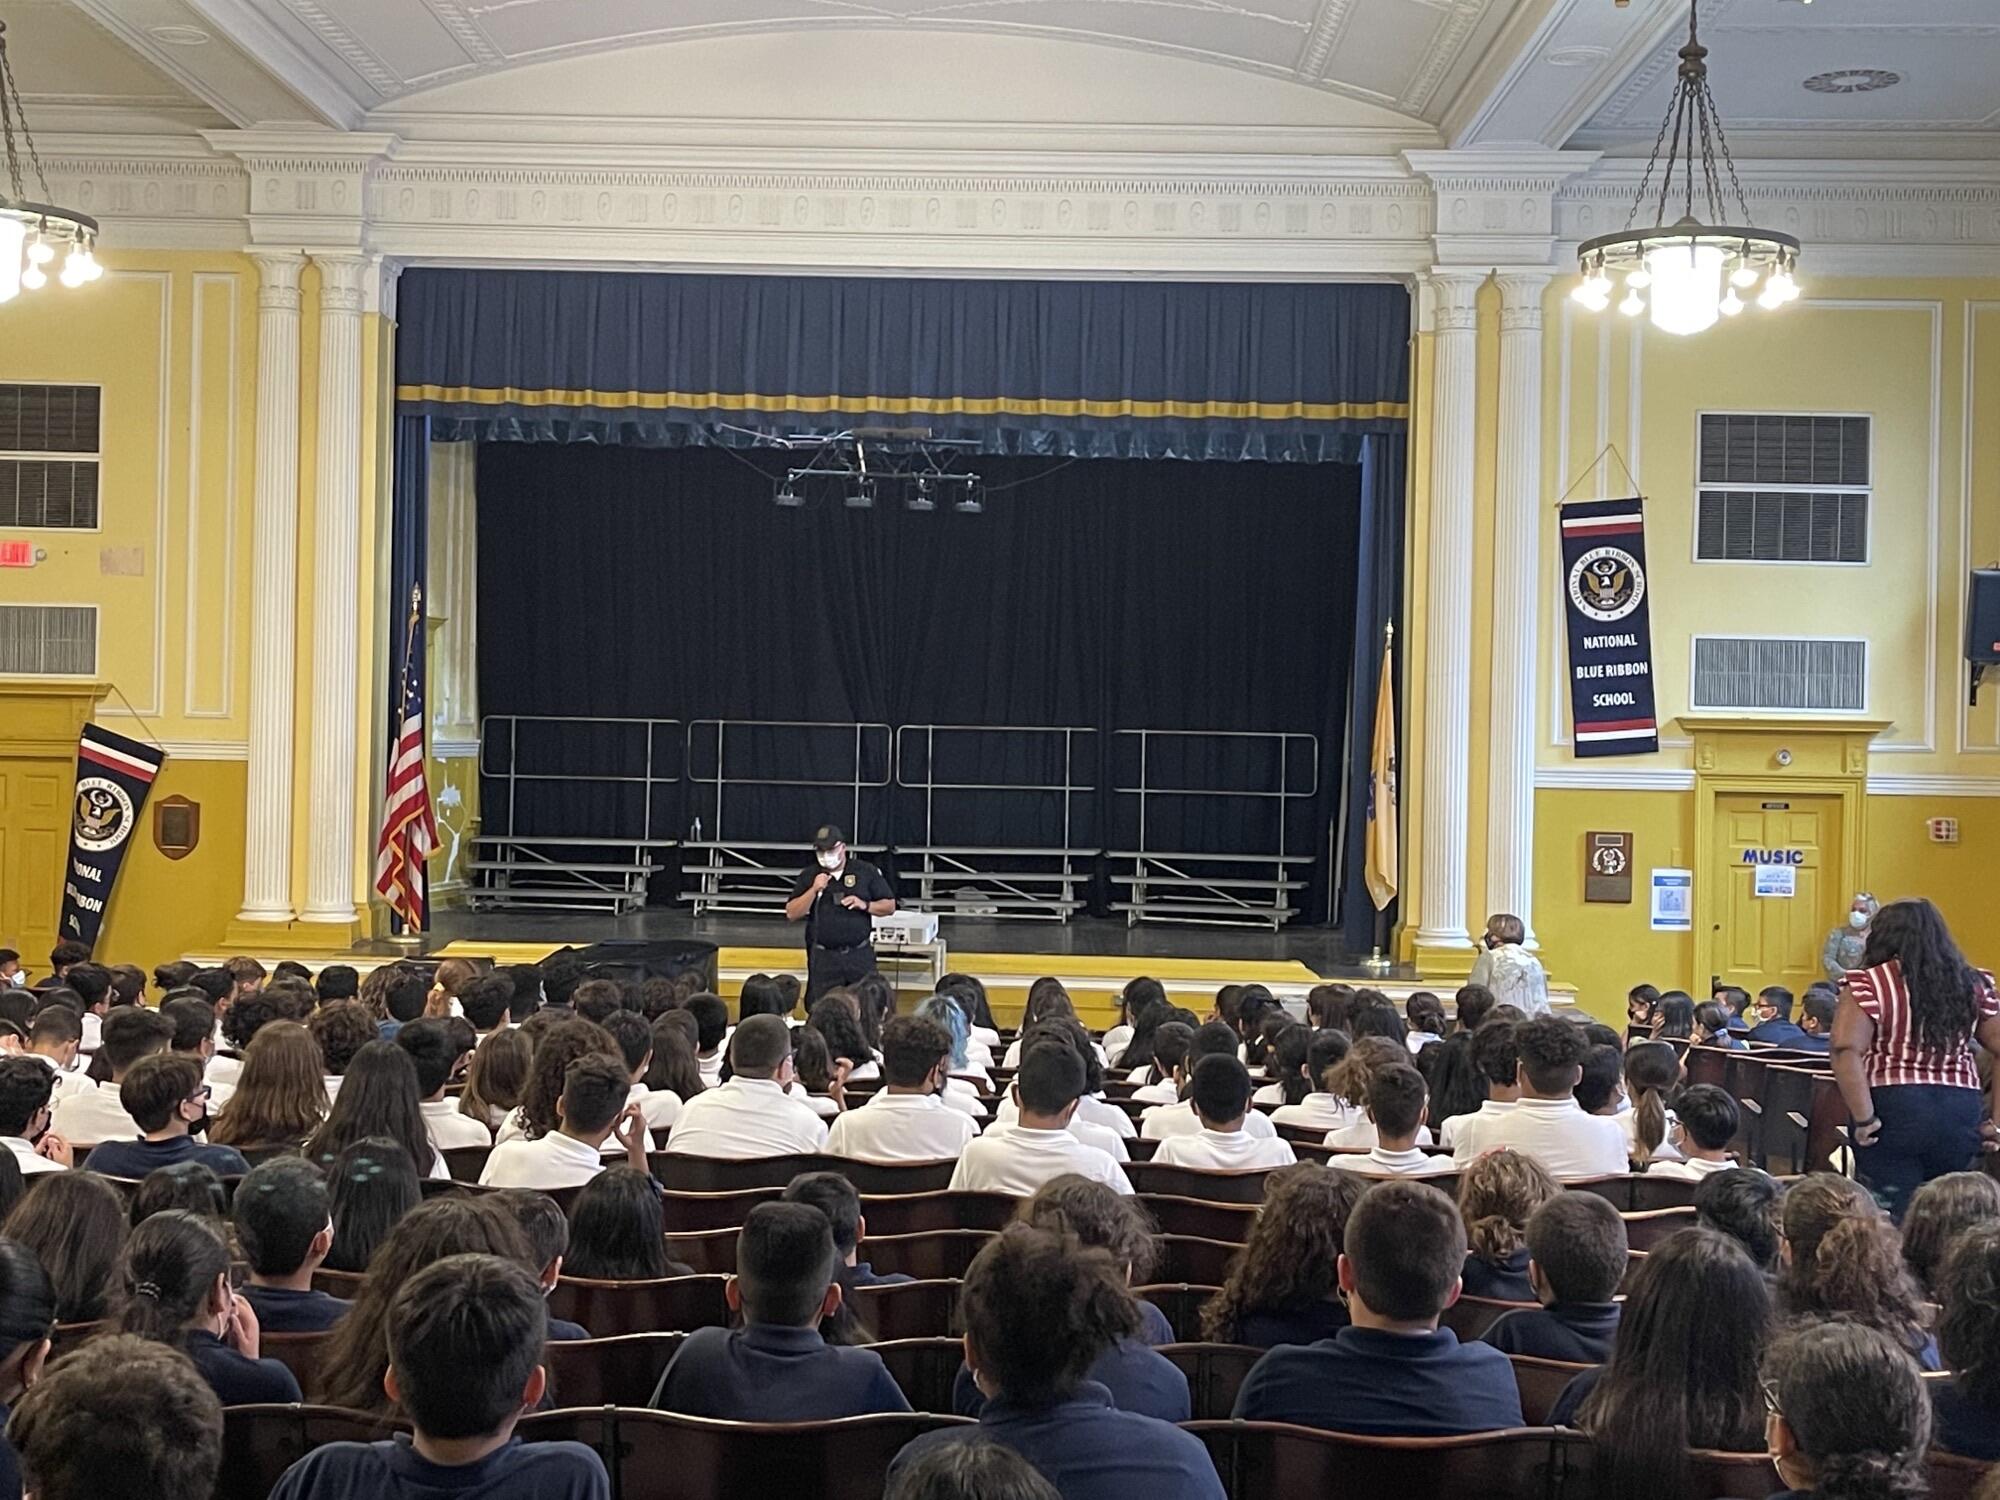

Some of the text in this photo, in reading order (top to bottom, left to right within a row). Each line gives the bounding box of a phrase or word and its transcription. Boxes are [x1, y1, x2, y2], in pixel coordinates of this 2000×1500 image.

[1584, 634, 1638, 649] NATIONAL
[1576, 661, 1648, 679] BLUE RIBBON
[1592, 692, 1636, 707] SCHOOL
[1743, 849, 1804, 864] MUSIC
